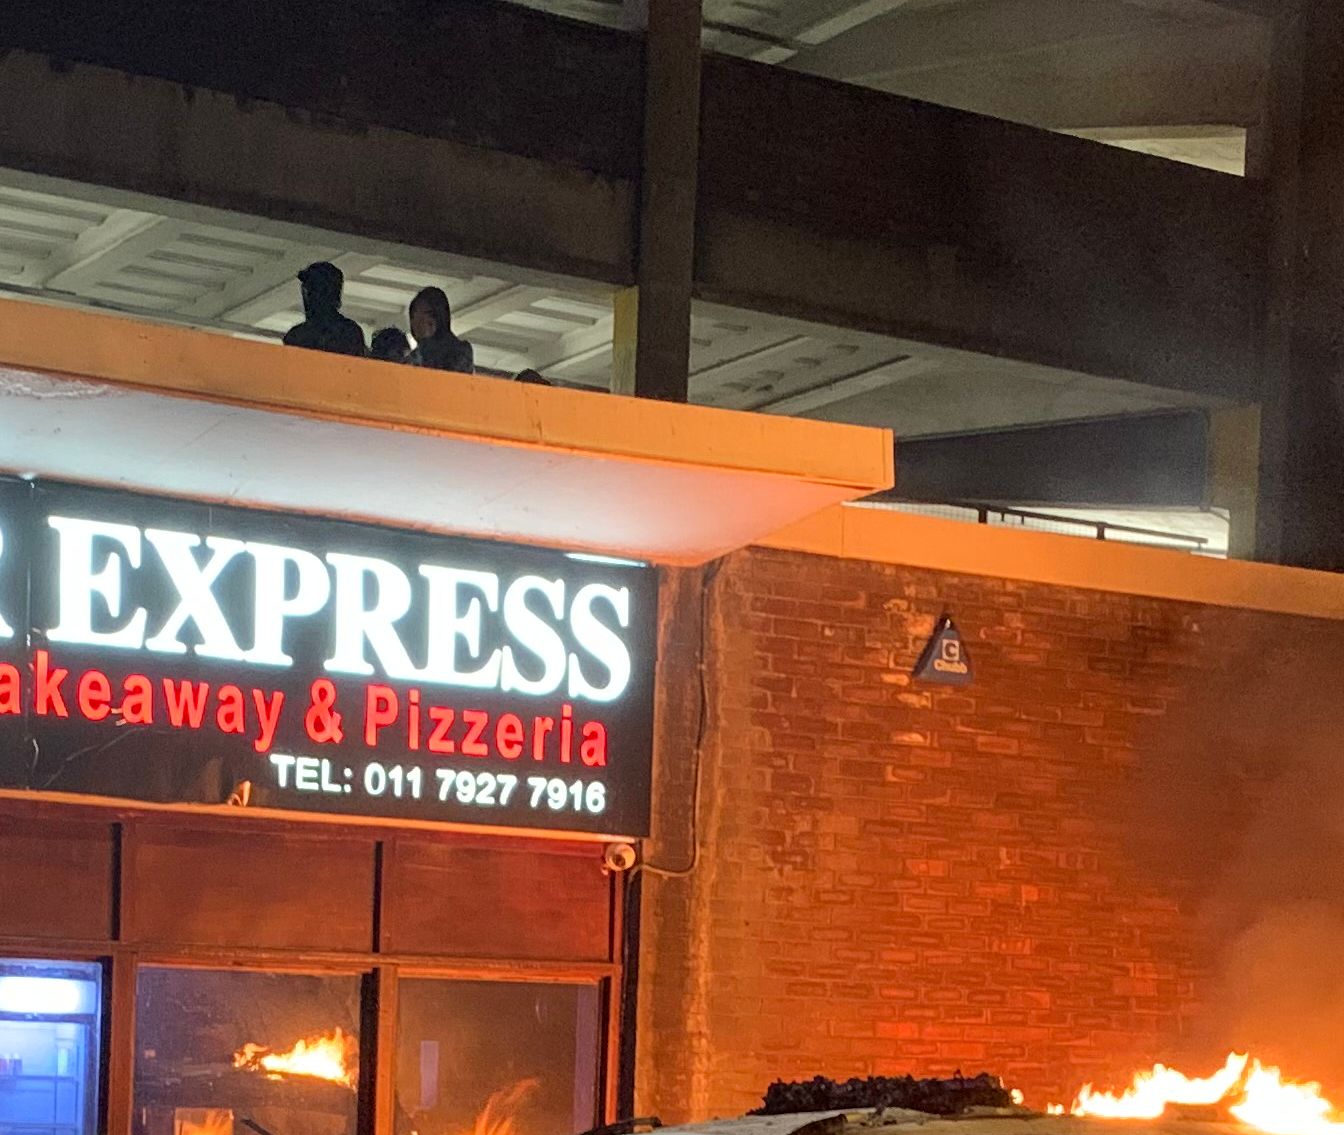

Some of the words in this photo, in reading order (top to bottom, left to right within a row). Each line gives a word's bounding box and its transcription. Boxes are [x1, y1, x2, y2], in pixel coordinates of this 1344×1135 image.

[46, 514, 632, 702] EXPRESS
[303, 677, 344, 747] &
[363, 683, 608, 768] Pizzeria
[269, 753, 353, 794] TEL:
[363, 761, 423, 800] 011
[435, 767, 514, 807] 7927
[526, 774, 607, 813] 7916
